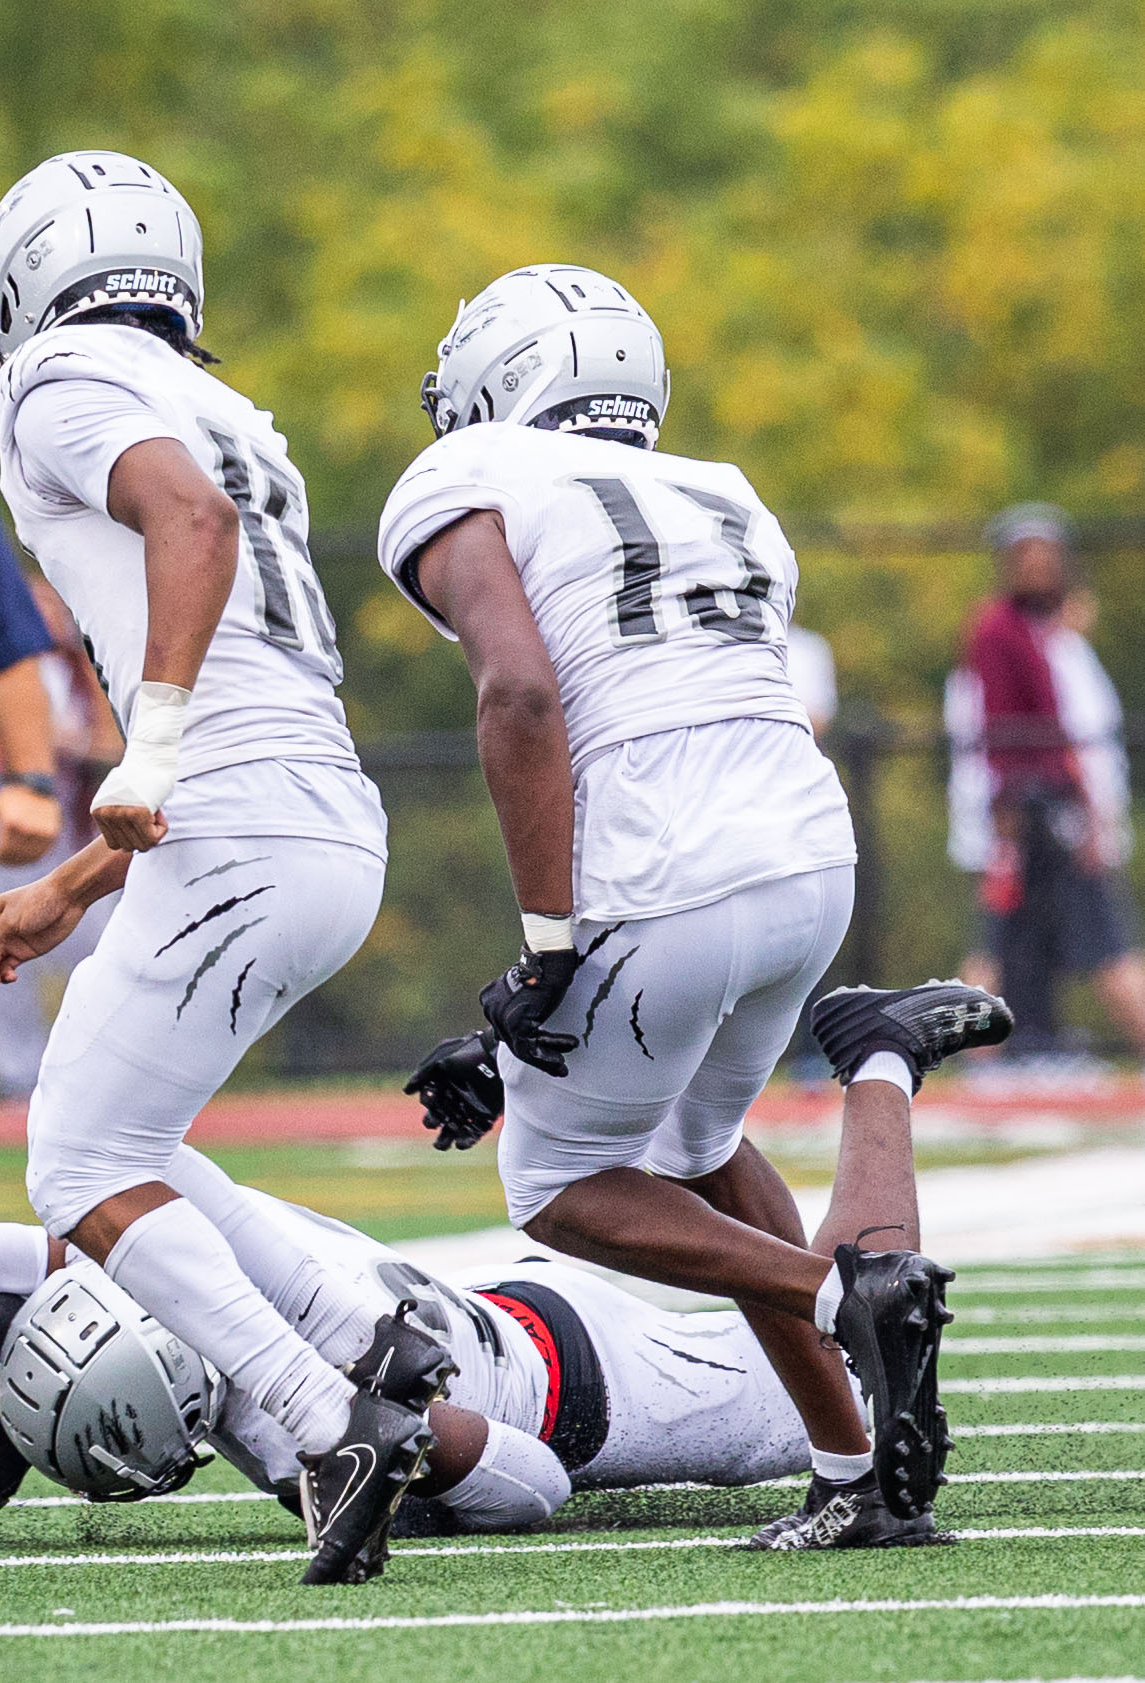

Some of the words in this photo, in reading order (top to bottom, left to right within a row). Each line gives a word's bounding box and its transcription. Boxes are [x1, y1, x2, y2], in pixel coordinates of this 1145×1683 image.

[105, 268, 176, 293] schutt
[588, 395, 650, 419] schutt
[557, 472, 775, 648] 13
